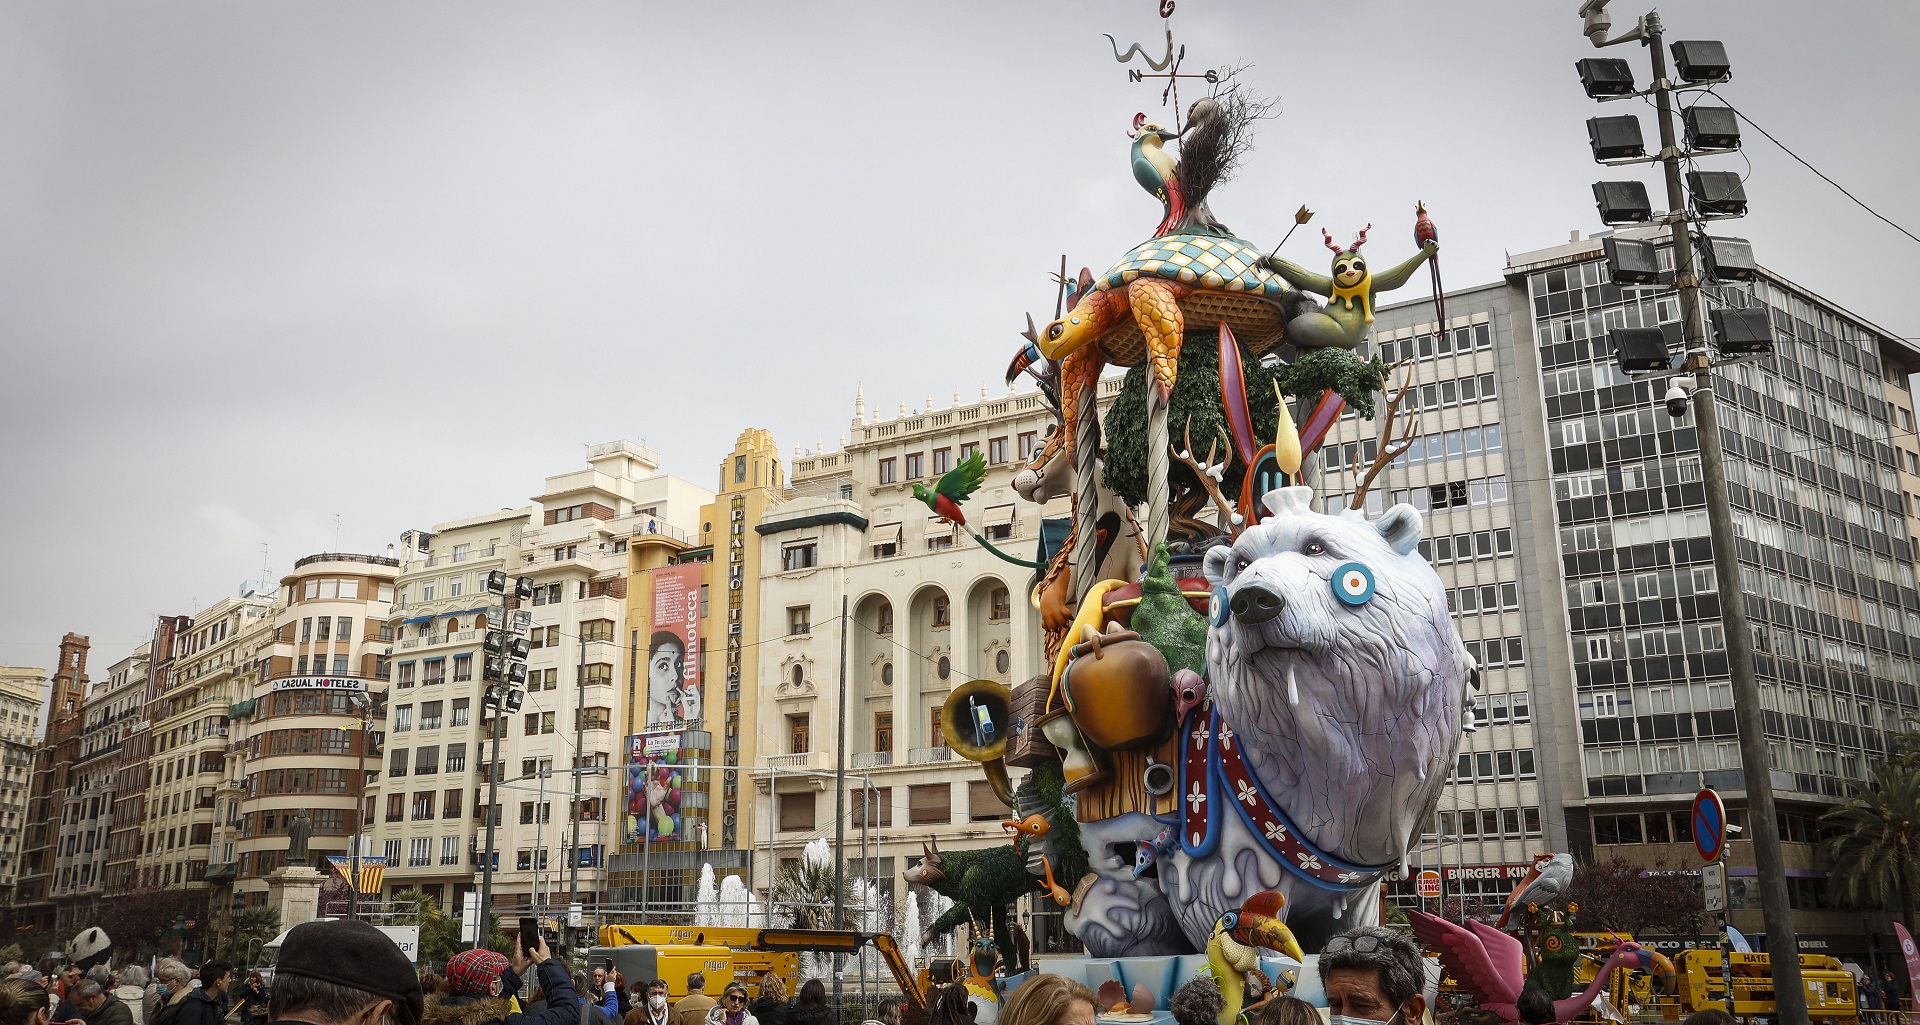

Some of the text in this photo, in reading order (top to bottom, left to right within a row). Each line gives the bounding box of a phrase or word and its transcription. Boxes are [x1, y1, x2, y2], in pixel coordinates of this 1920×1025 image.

[1129, 69, 1141, 82] N
[1206, 70, 1218, 83] S
[683, 589, 697, 680] filmoteca
[723, 509, 743, 842] RIALTO TEATRE FILMOTECA
[281, 679, 359, 688] CASUAL HOTELES
[1381, 871, 1398, 881] NG
[1448, 867, 1531, 879] BURGER KIN
[670, 927, 694, 941] rigar
[1744, 954, 1767, 963] HA16
[704, 959, 729, 972] rigar
